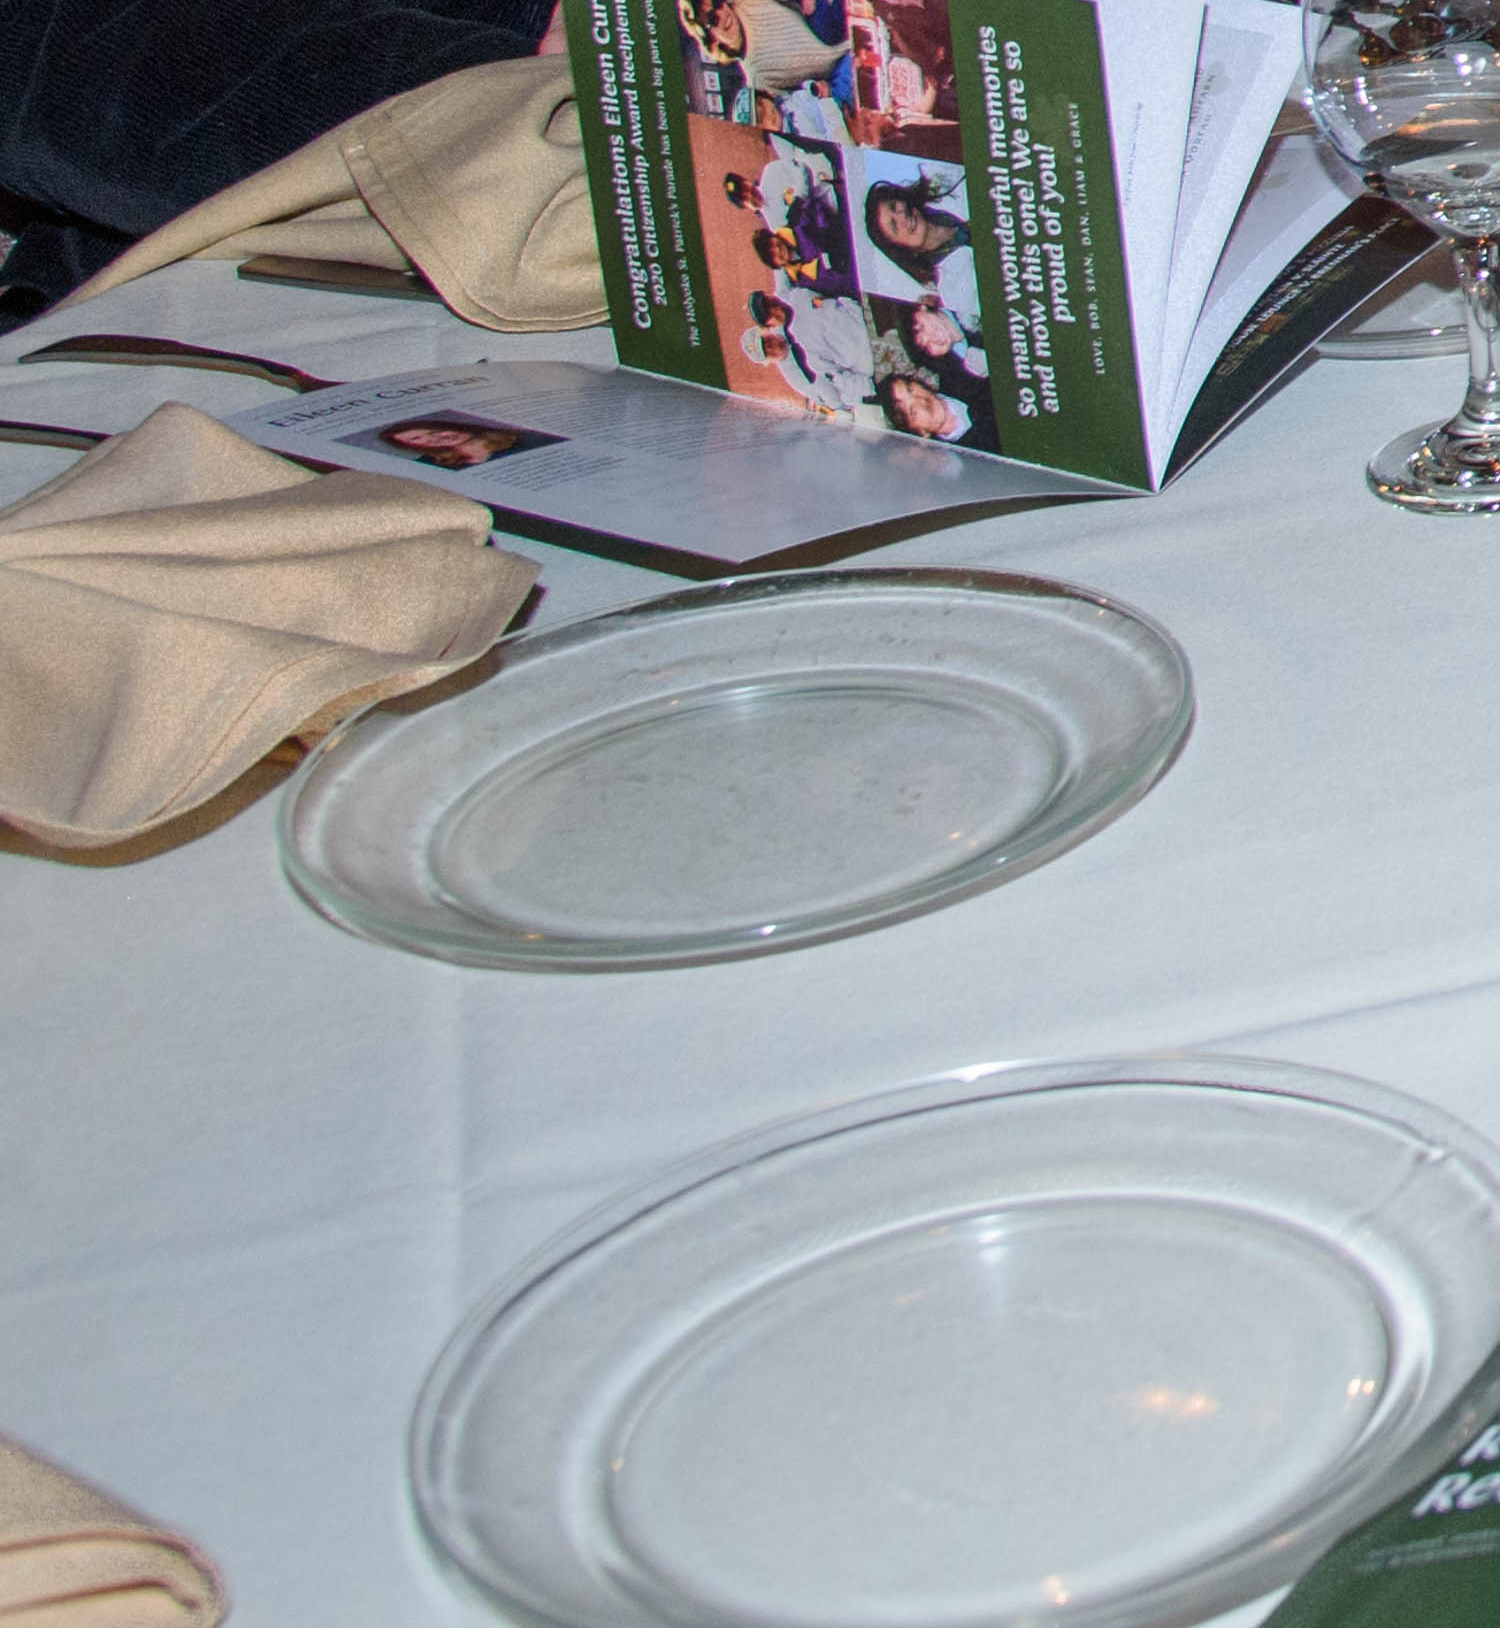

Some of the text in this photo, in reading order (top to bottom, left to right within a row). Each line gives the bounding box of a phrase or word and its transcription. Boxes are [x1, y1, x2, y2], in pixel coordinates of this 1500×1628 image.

[596, 53, 622, 125] Eileen
[625, 89, 644, 150] Award
[606, 134, 653, 329] Congratulations
[632, 155, 662, 258] Citizenship
[978, 25, 1039, 417] So many wonderful memories
[1002, 40, 1060, 413] and now this one! We are so
[1033, 143, 1076, 323] proud of you!
[651, 263, 668, 306] 2020
